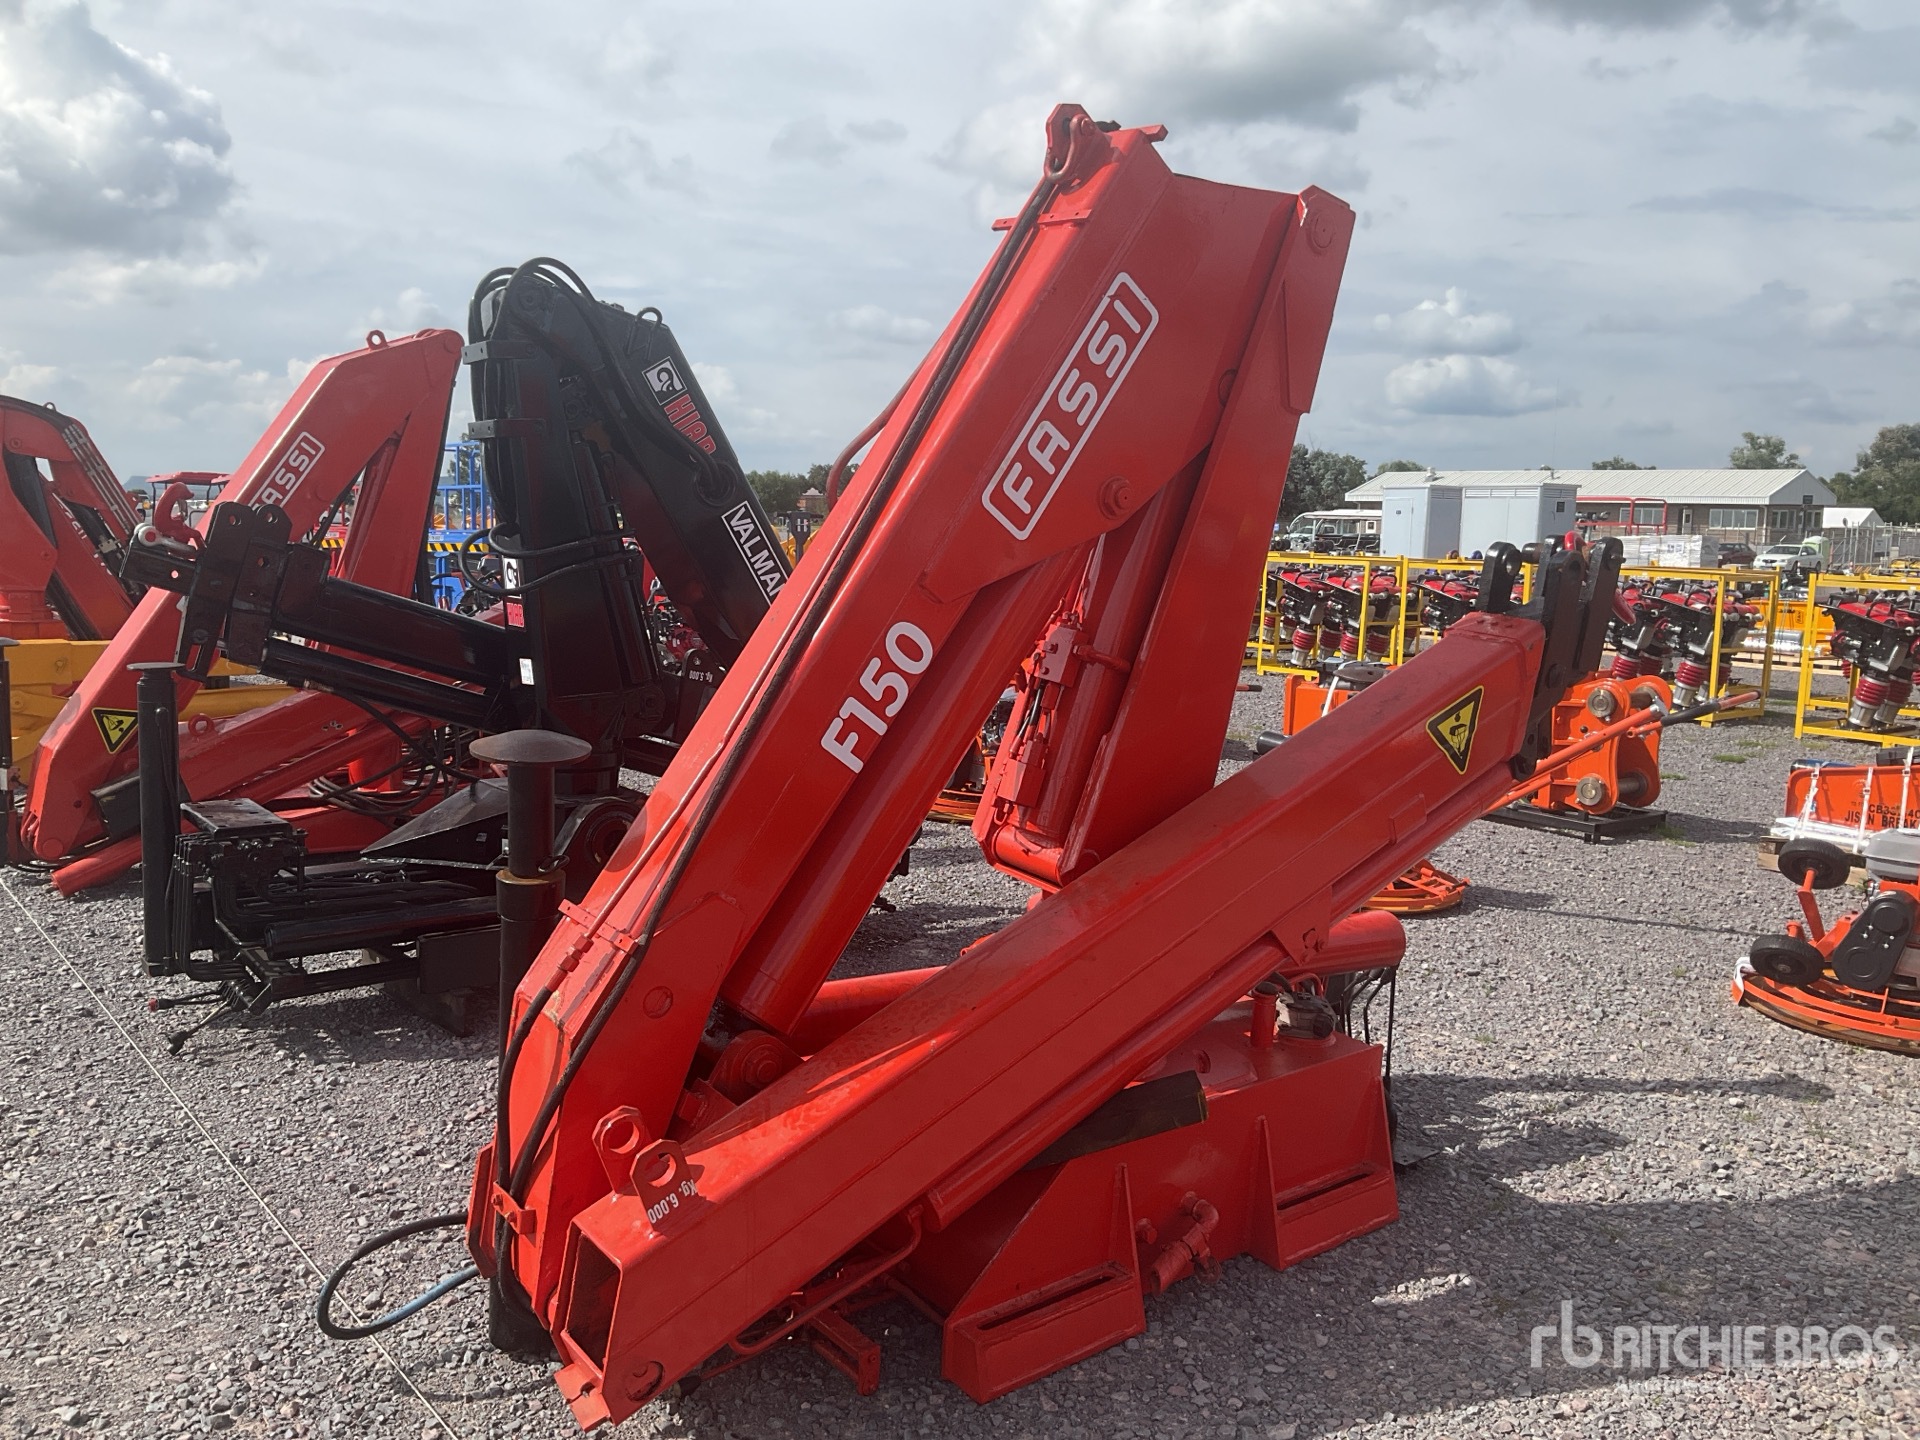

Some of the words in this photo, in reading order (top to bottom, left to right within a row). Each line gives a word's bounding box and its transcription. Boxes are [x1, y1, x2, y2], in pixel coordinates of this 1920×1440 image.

[1003, 299, 1141, 514] FASSI
[252, 441, 316, 511] ASSI
[821, 621, 933, 774] F150
[1845, 810, 1874, 825] JISN
[647, 1192, 679, 1224] 6.000
[679, 1179, 698, 1196] Kg.
